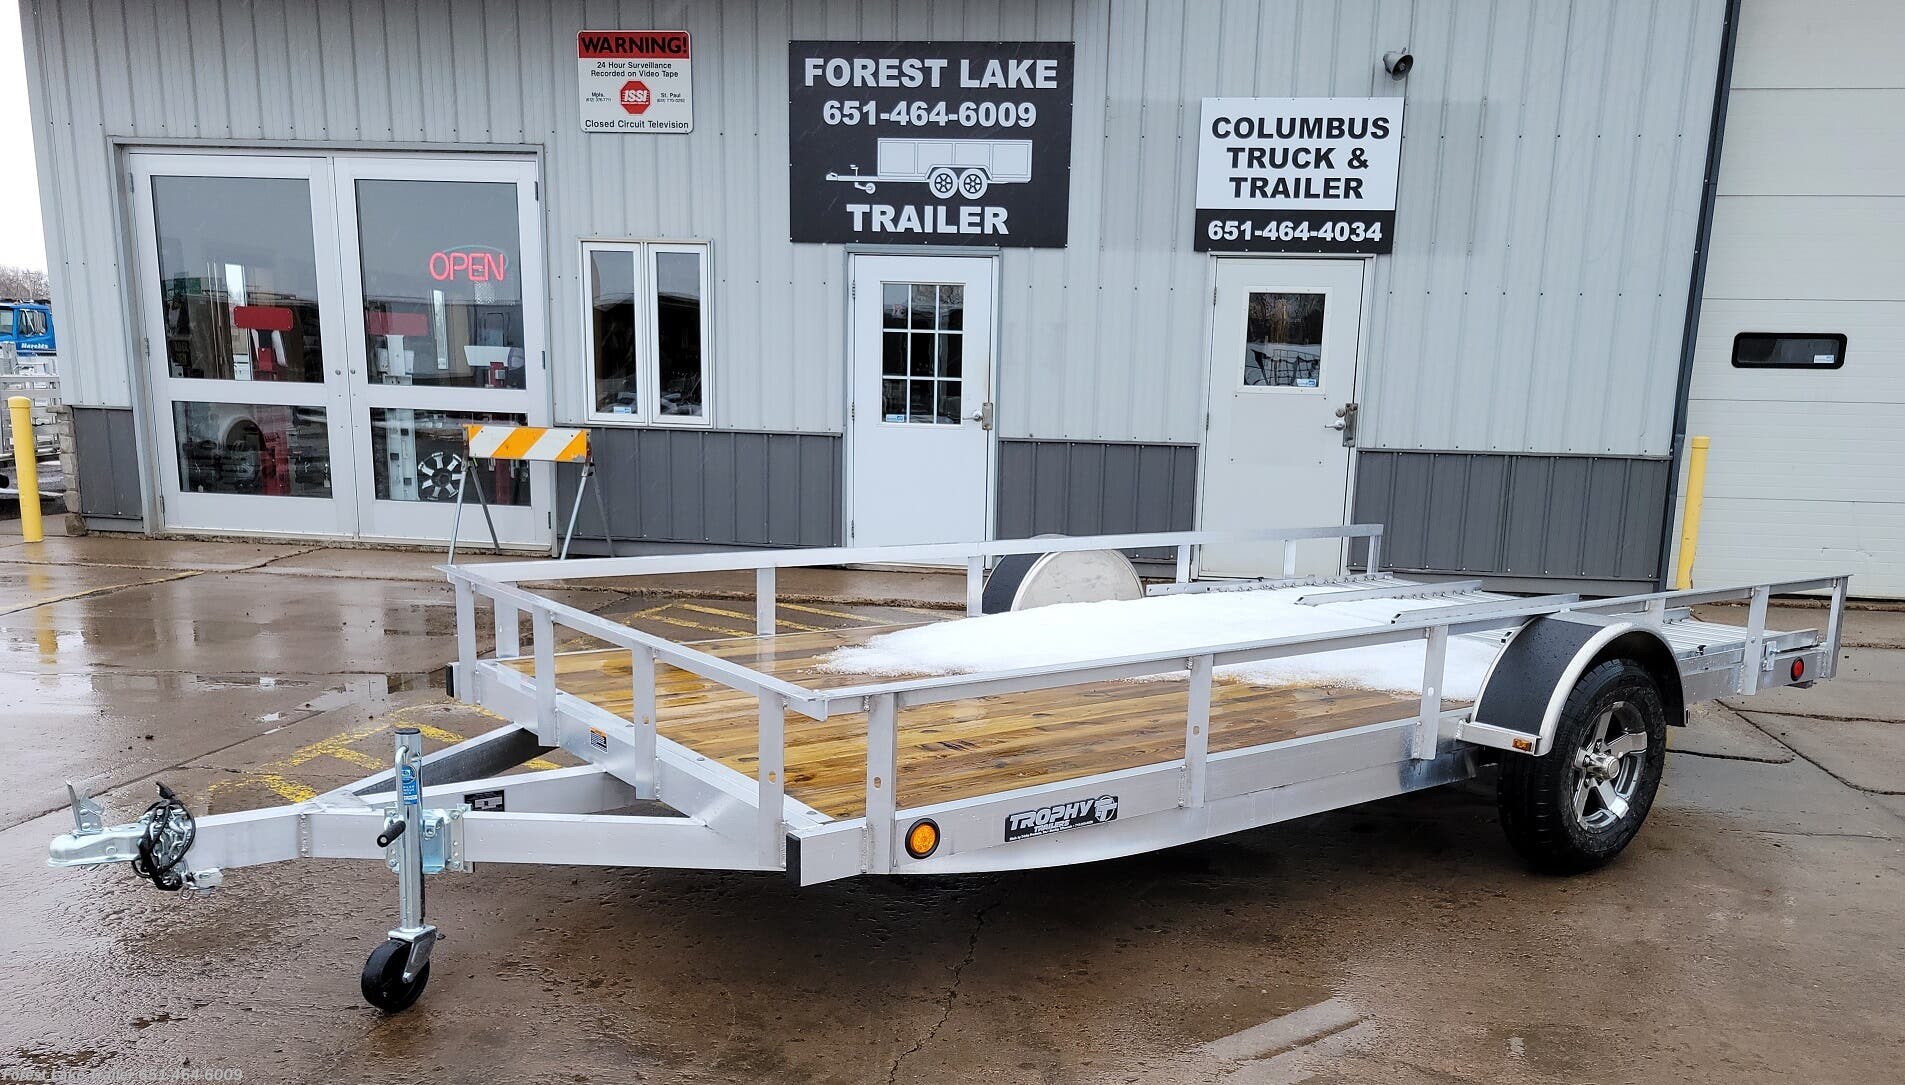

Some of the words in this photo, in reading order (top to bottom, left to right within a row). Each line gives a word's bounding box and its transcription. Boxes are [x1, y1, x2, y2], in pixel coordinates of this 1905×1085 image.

[581, 36, 687, 54] WARNING!
[662, 70, 679, 78] Tape
[804, 57, 948, 88] FOREST
[960, 59, 1058, 89] LAKE
[585, 120, 615, 128] Closed
[617, 120, 645, 128] Circuit
[648, 120, 689, 129] Television
[823, 100, 1037, 128] 651-464-6009
[1211, 117, 1390, 139] COLUMBUS
[1226, 147, 1336, 169] TRUCK
[1347, 147, 1369, 169] &
[1229, 177, 1364, 200] TRAILER
[846, 204, 1009, 235] TRAILER
[1207, 220, 1382, 241] 651-464-4034
[429, 252, 504, 281] OPEN
[1010, 799, 1094, 831] TROPHY
